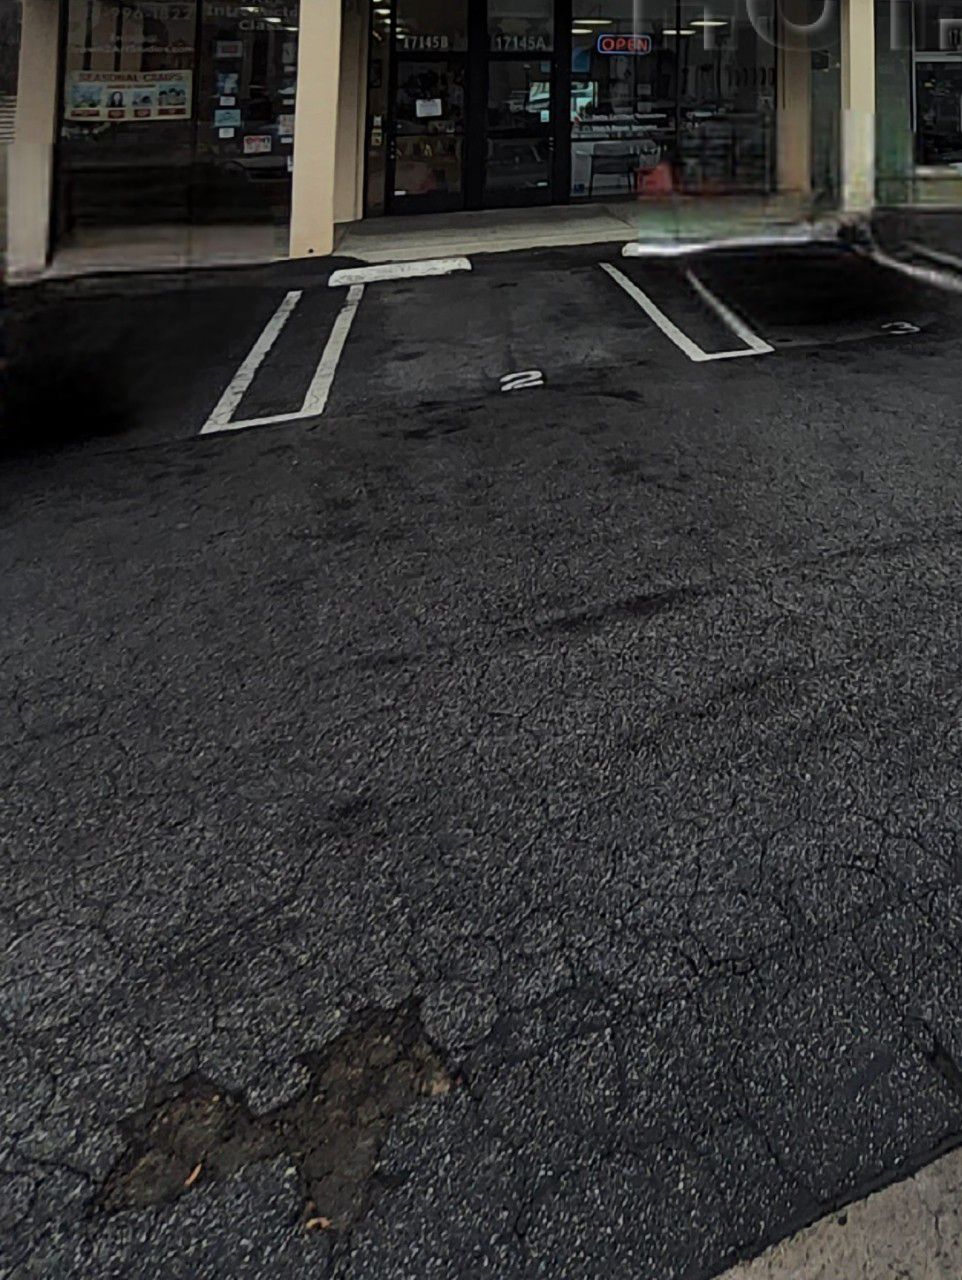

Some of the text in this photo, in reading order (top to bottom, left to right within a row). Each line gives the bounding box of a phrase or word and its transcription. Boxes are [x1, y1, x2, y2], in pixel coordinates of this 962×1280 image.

[403, 34, 449, 50] 17145B
[495, 35, 546, 50] 17145A
[601, 37, 649, 52] OPEN
[500, 370, 545, 392] 2
